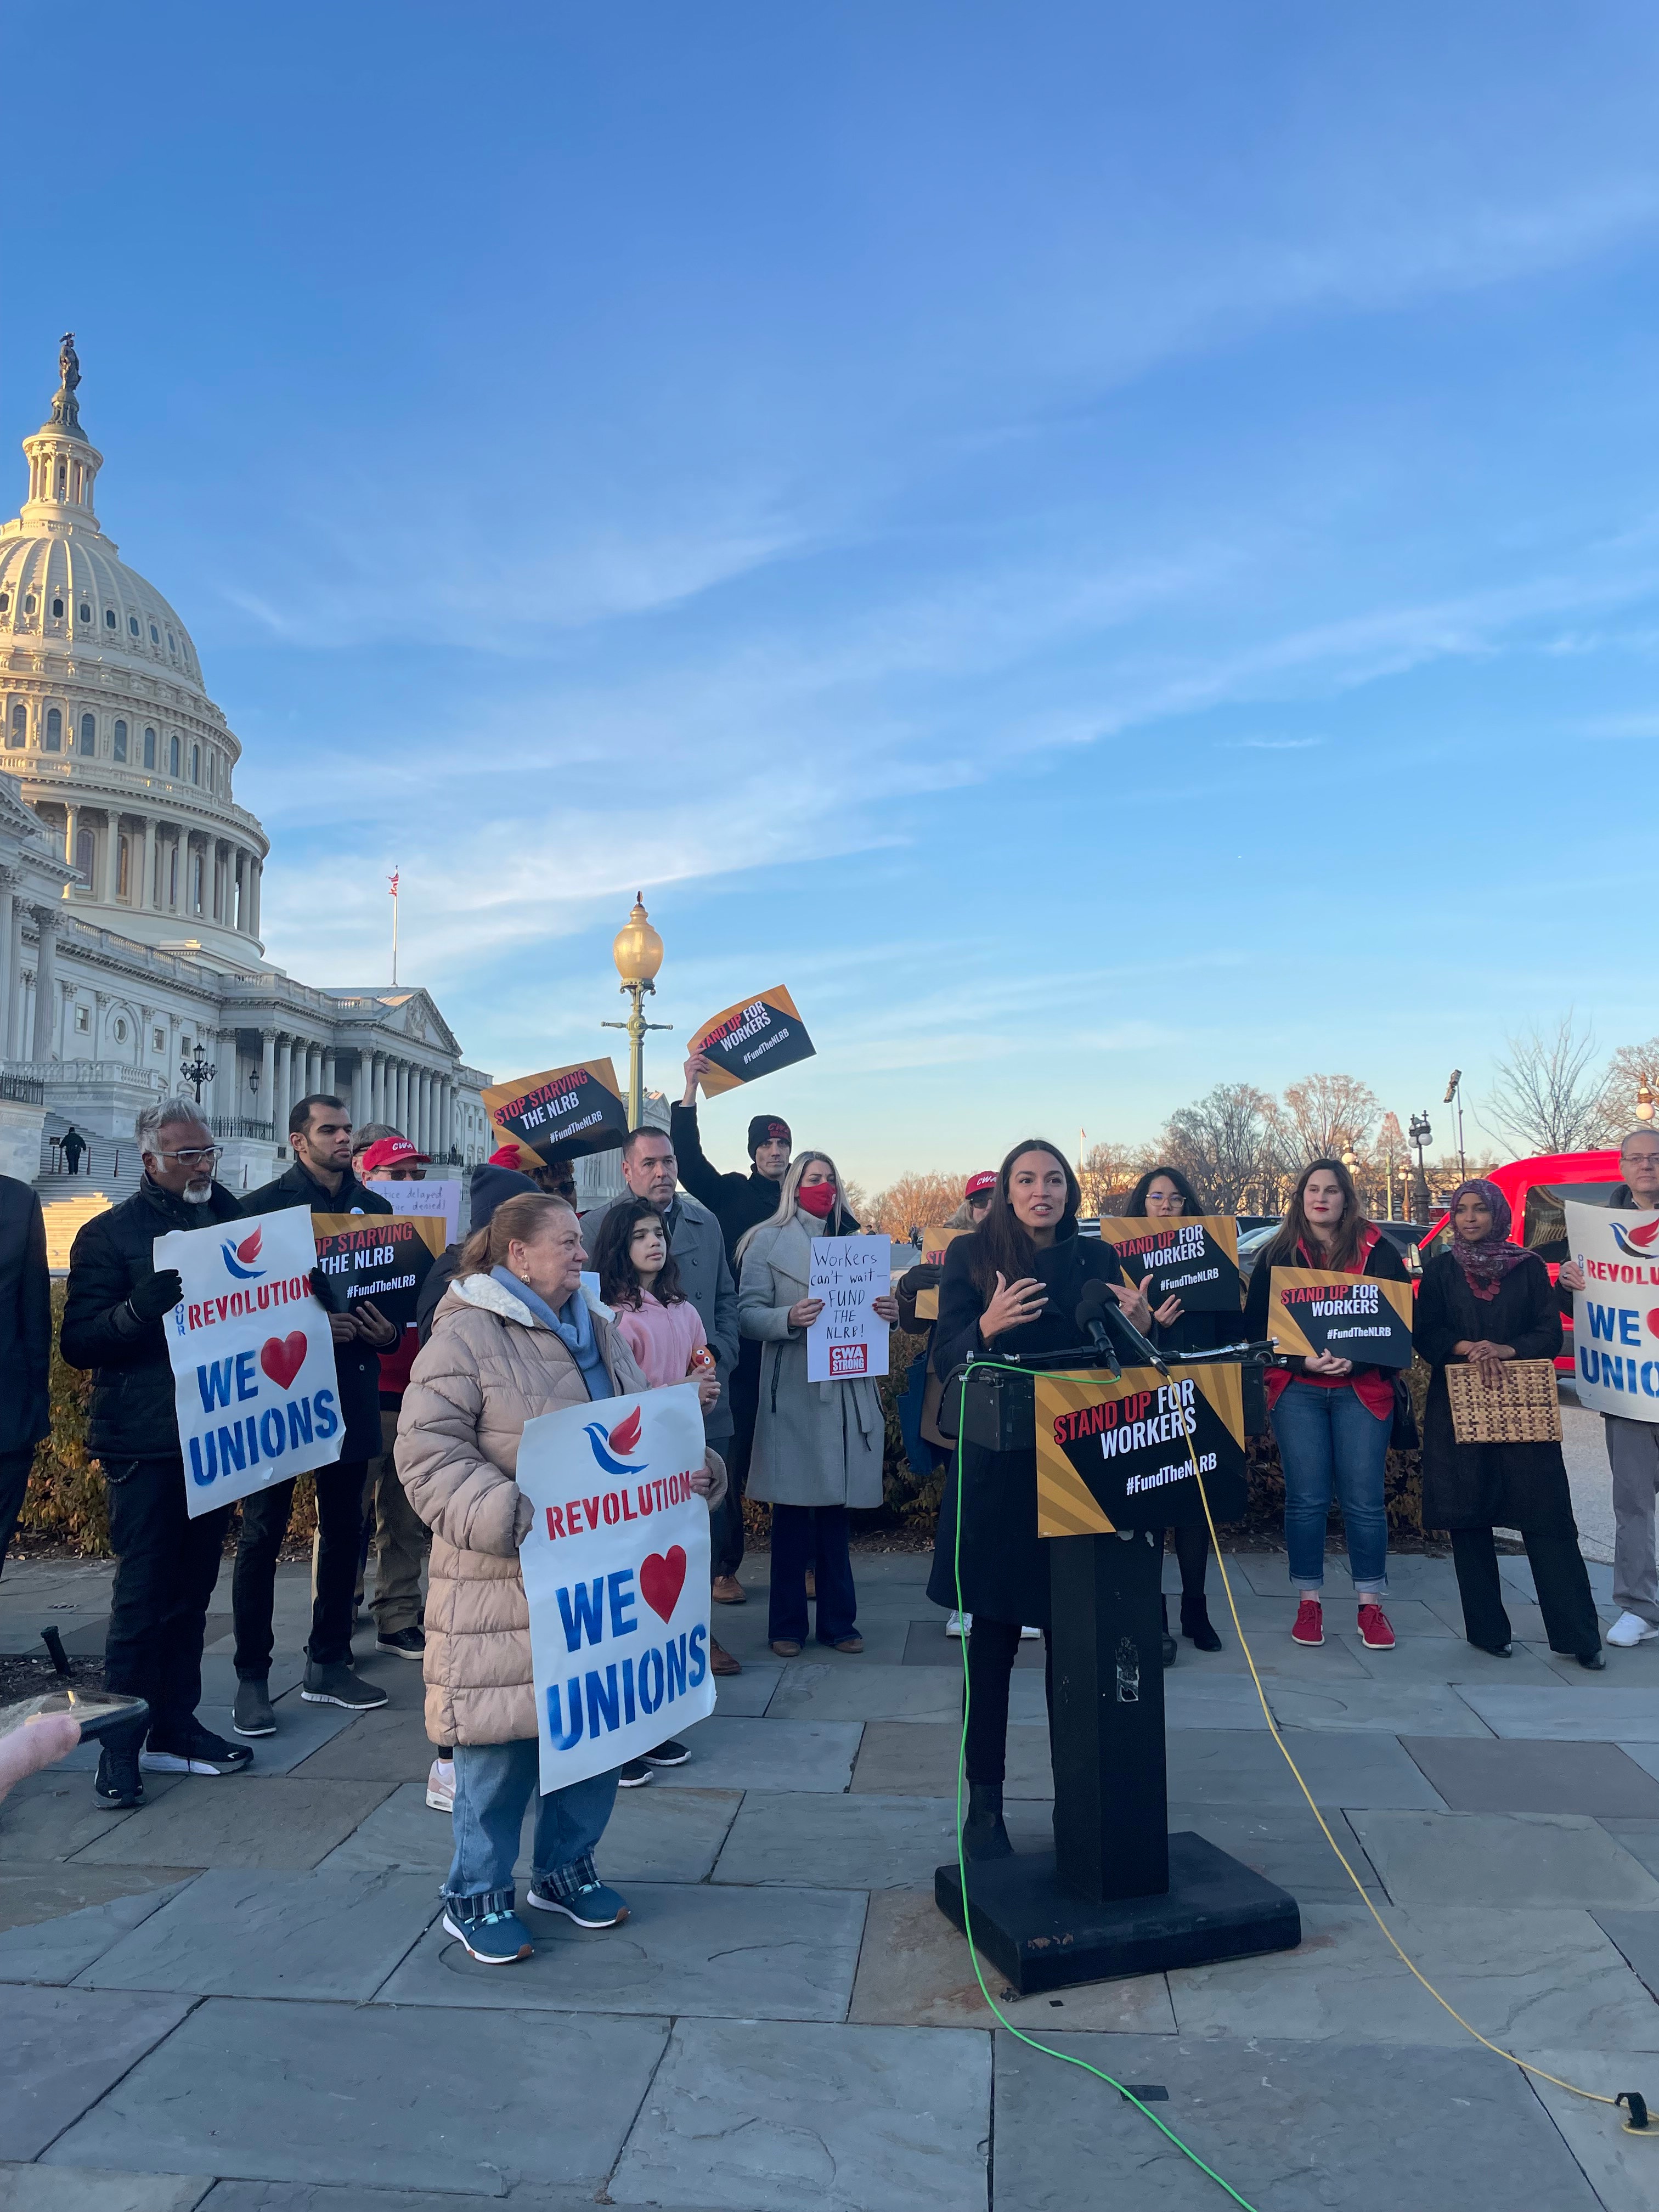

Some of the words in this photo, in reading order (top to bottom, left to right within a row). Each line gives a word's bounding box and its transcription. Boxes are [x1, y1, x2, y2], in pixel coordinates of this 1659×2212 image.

[698, 1025, 727, 1049] TAND
[726, 1014, 742, 1031] UP
[742, 1001, 766, 1022] FOR
[720, 1012, 771, 1052] WORKERS
[743, 1028, 789, 1065] #FundTheNLRB
[494, 1097, 526, 1125] STOP
[529, 1069, 588, 1107] STARVING
[520, 1107, 546, 1130] THE
[546, 1092, 579, 1119] NLRB
[550, 1110, 603, 1144] #FundTheNLRB
[392, 1142, 413, 1150] CWA
[407, 1186, 442, 1202] delayed
[977, 1176, 997, 1186] CWA
[315, 1238, 332, 1256] OP
[338, 1223, 412, 1252] STARVING
[1113, 1237, 1154, 1258] STAND
[1158, 1231, 1175, 1248] UP
[1179, 1224, 1204, 1244] FOR
[1143, 1242, 1205, 1269] WORKERS
[320, 1254, 349, 1276] THE
[354, 1246, 394, 1270] NLRB
[926, 1251, 946, 1265] ST
[347, 1274, 415, 1299] #FundTheNLRB
[811, 1270, 843, 1286] can't
[1160, 1268, 1218, 1291] #FundTheNLRB
[189, 1273, 315, 1330] REVOLUTION
[829, 1289, 865, 1307] FUND
[1281, 1286, 1324, 1305] STAND
[1329, 1285, 1348, 1300] UP
[1352, 1284, 1378, 1299] FOR
[1312, 1300, 1379, 1317] WORKERS
[175, 1304, 185, 1336] OUR
[827, 1324, 864, 1339] NLRB!
[833, 1310, 856, 1323] THE
[1587, 1301, 1641, 1347] WE
[1327, 1327, 1392, 1340] #FundTheNLRB
[832, 1346, 864, 1360] CWA
[832, 1358, 865, 1372] STRONG
[197, 1350, 258, 1414] WE
[1054, 1402, 1117, 1445] STAND
[1124, 1391, 1151, 1423] UP
[1158, 1379, 1194, 1414] FOR
[189, 1390, 338, 1487] UNIONS
[1101, 1407, 1197, 1459] WORKERS
[546, 1470, 691, 1541] REVOLUTION
[555, 1568, 637, 1653] WE
[546, 1623, 706, 1751] UNIONS
